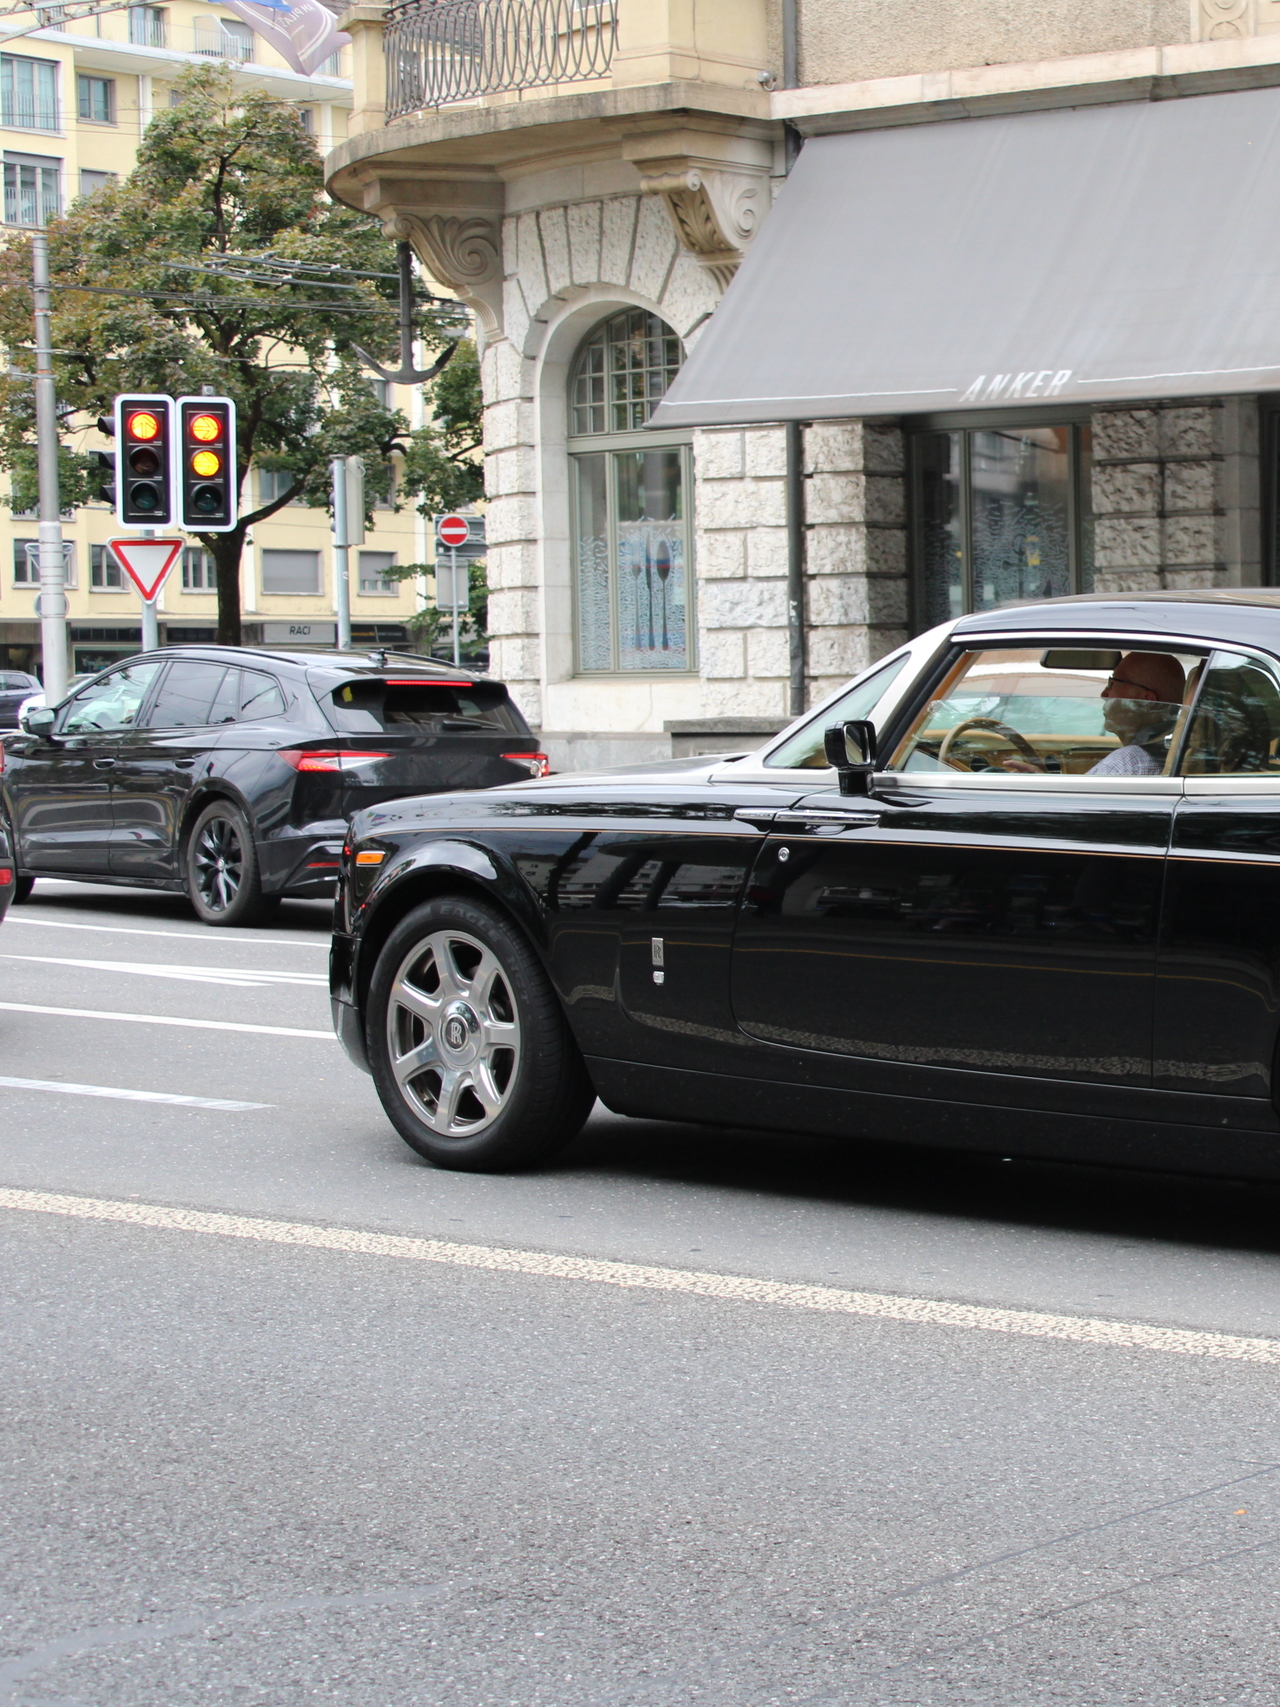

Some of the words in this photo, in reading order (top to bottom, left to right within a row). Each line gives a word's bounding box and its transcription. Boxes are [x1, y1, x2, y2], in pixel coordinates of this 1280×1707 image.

[959, 369, 1073, 403] ANKER
[289, 625, 311, 636] RACI
[439, 904, 504, 943] EAGLE
